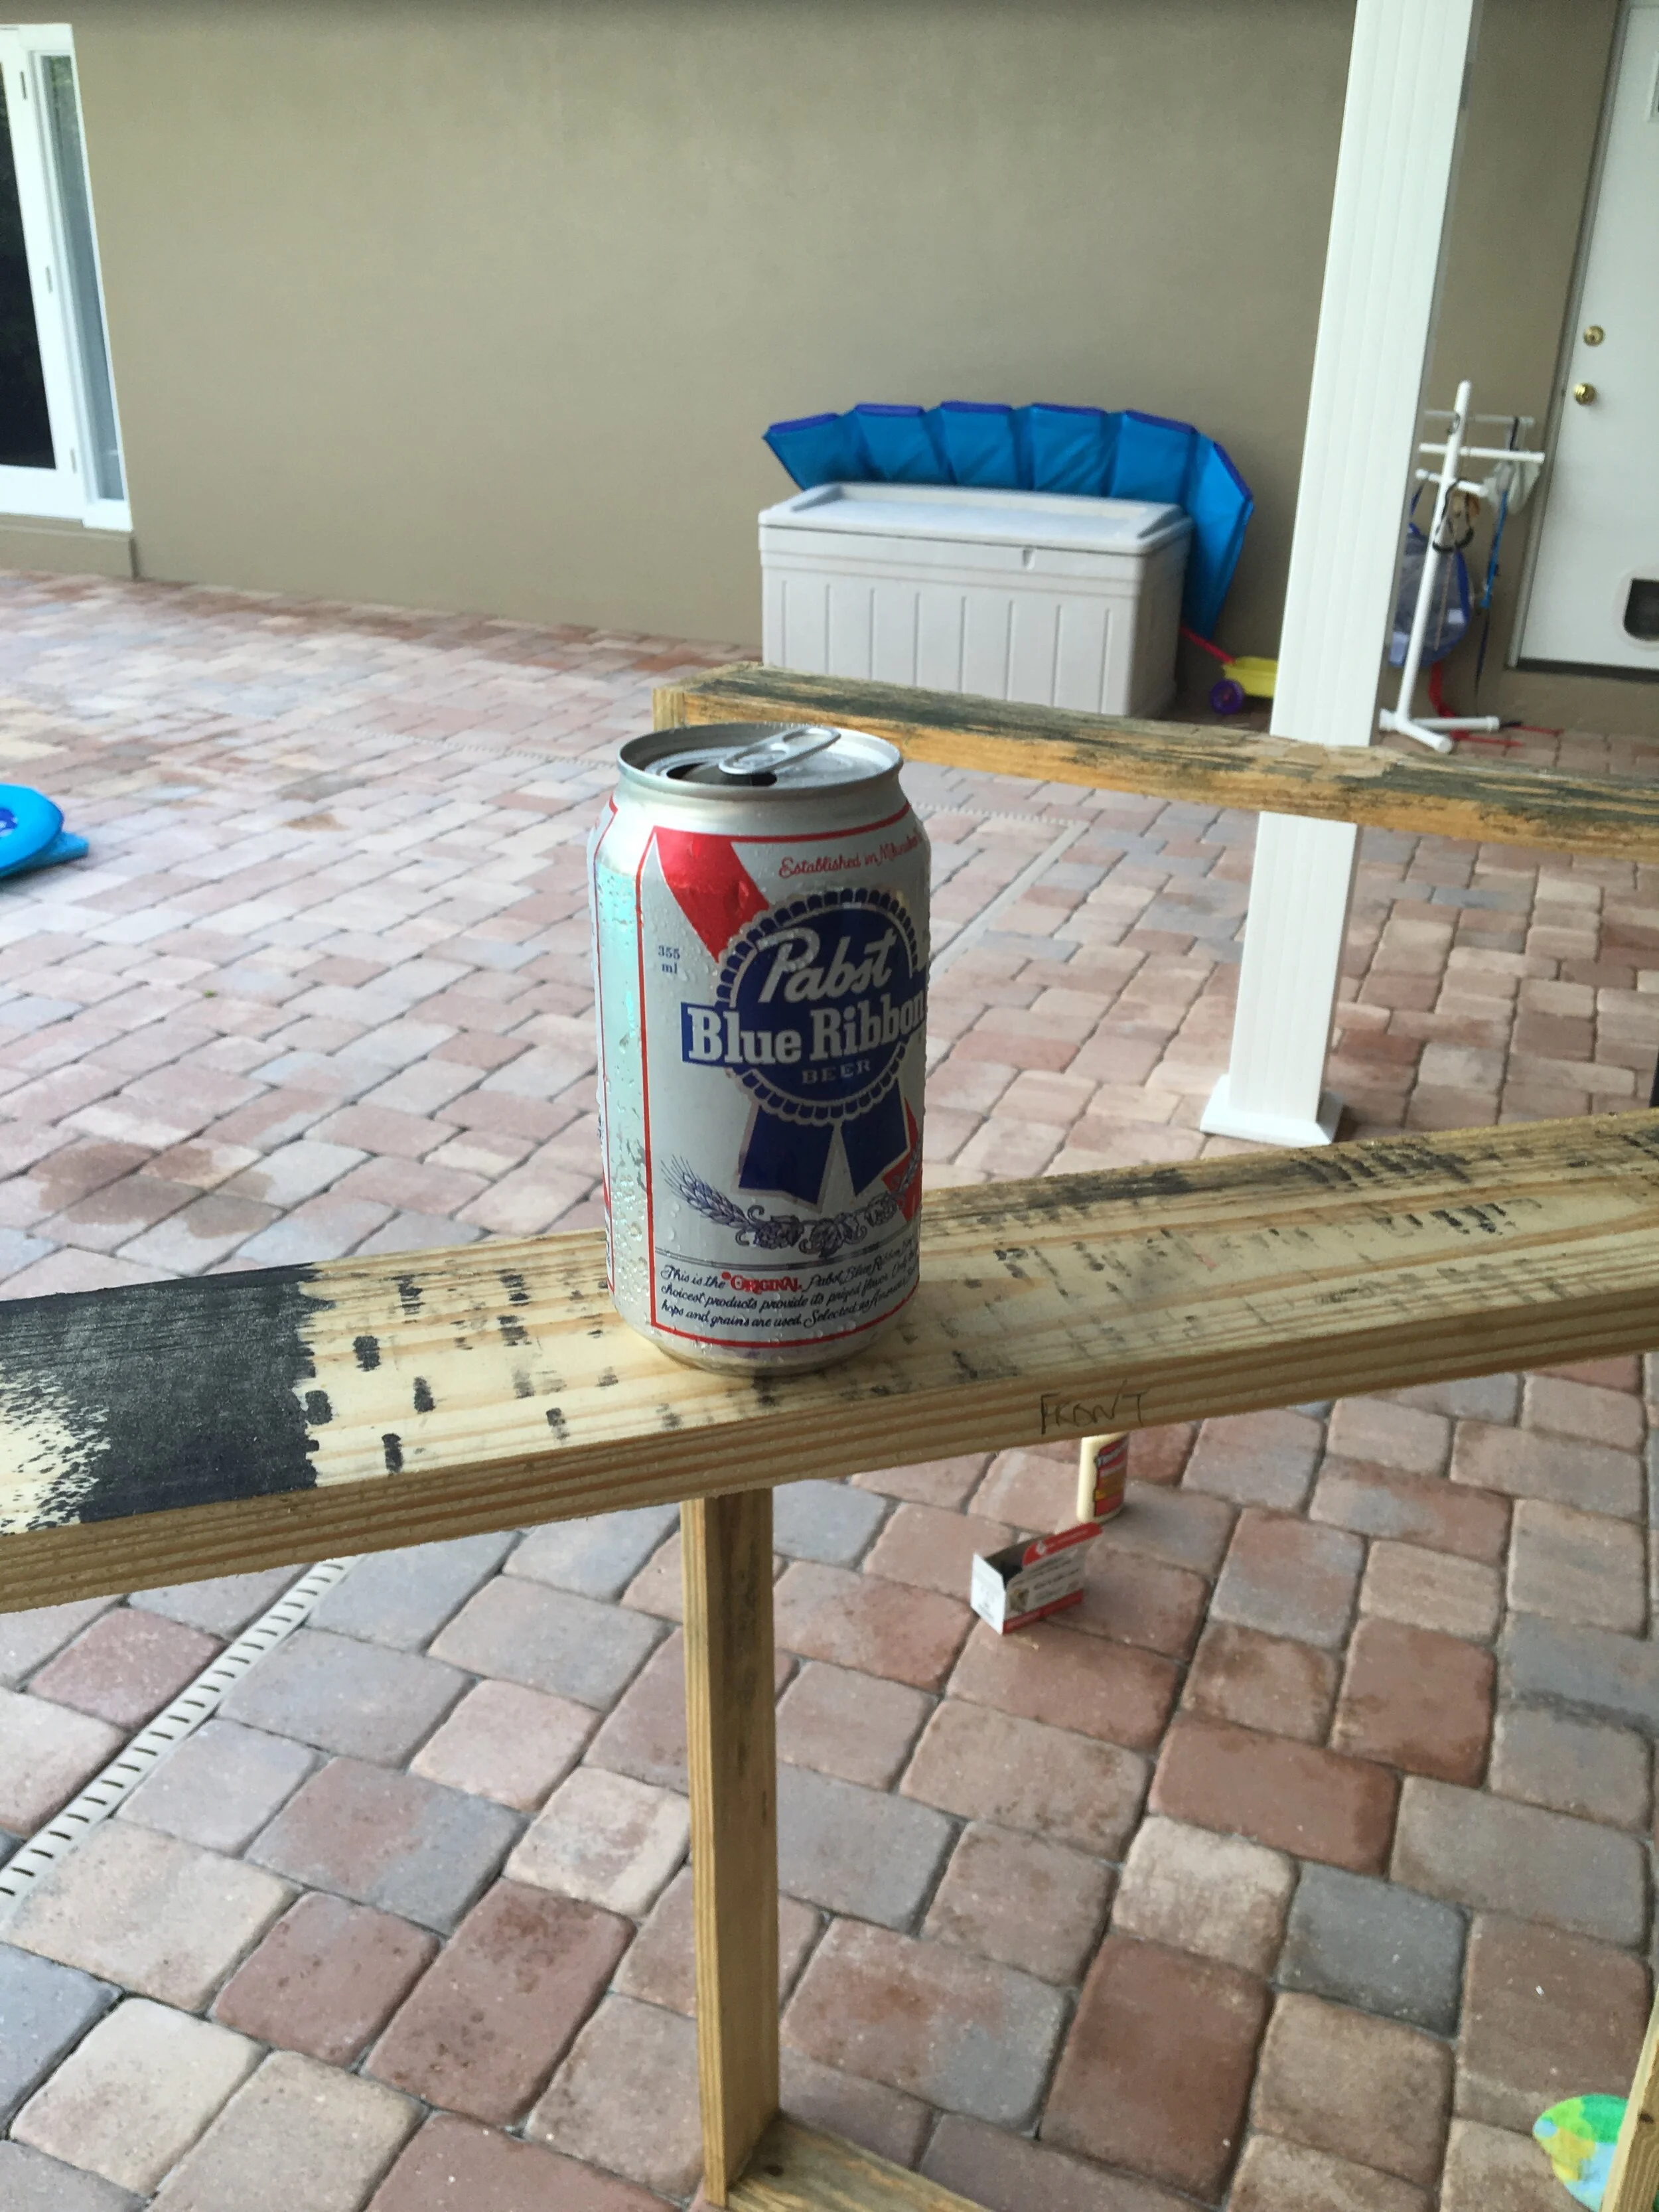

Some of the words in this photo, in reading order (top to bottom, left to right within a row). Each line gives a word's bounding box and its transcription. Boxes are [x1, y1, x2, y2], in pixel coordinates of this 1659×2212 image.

[778, 852, 861, 879] Established
[658, 944, 681, 960] 355
[757, 927, 897, 1003] Pabst
[661, 961, 678, 975] ml
[687, 1005, 802, 1065] Blue
[809, 990, 925, 1061] Ribbon
[802, 1059, 871, 1084] BEER
[660, 1264, 689, 1282] This
[691, 1274, 703, 1286] is
[704, 1274, 727, 1290] the
[661, 1282, 705, 1304] choicest
[703, 1294, 758, 1310] products
[758, 1294, 808, 1313] provide
[810, 1295, 825, 1306] its
[661, 1299, 684, 1317] hops
[685, 1310, 709, 1325] and
[711, 1315, 750, 1327] grains
[751, 1318, 772, 1327] are
[804, 1300, 857, 1327] Selected
[1040, 1378, 1148, 1436] FRONT
